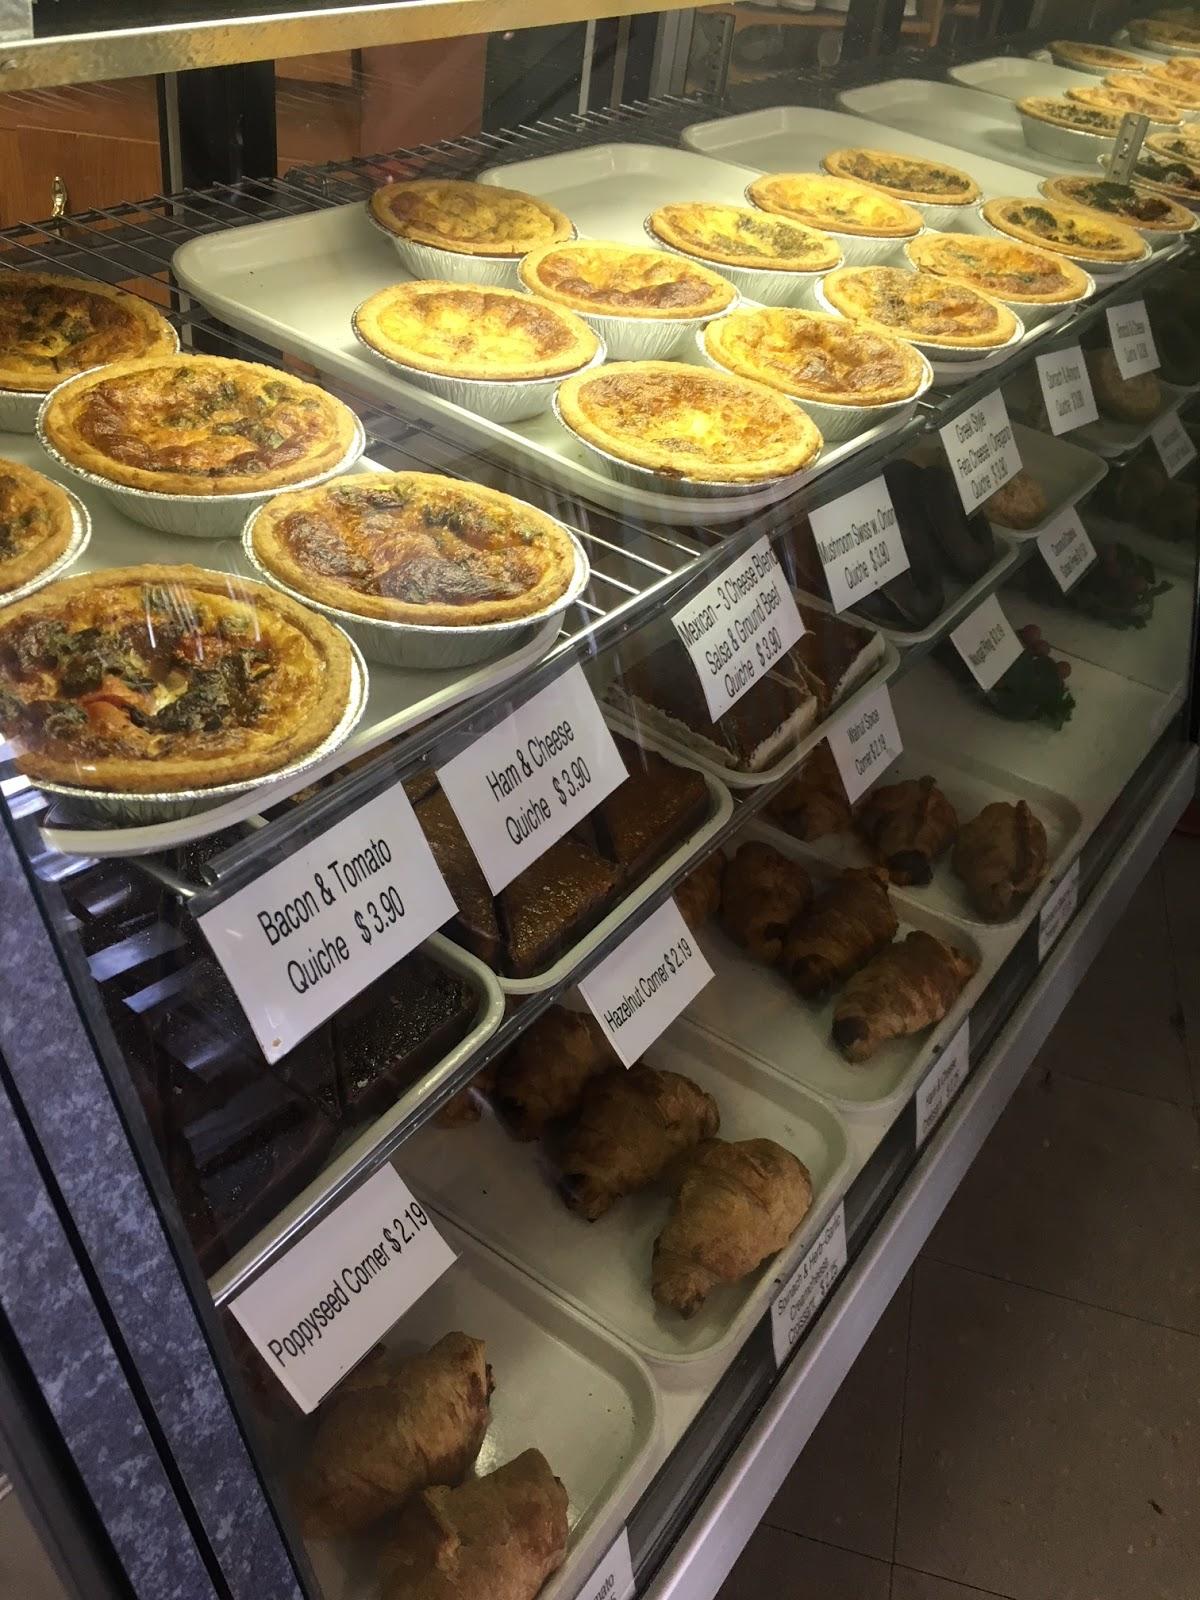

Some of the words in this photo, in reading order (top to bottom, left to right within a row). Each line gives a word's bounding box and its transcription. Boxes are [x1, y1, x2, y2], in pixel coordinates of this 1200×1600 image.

[678, 607, 718, 648] Mexican
[717, 587, 731, 611] 3
[724, 566, 758, 604] Cheese
[705, 641, 733, 675] Salsa
[727, 628, 740, 652] &
[734, 599, 766, 643] Ground
[759, 581, 781, 615] Beef
[724, 660, 755, 698] Quiche
[485, 764, 522, 802] Ham
[516, 749, 534, 778] &
[527, 720, 574, 768] Cheese
[505, 798, 551, 845] Quiche
[257, 891, 320, 946] Bacon
[314, 873, 336, 906] &
[327, 839, 392, 893] Tomato
[287, 936, 350, 994] Quiche
[603, 986, 646, 1033] Hazelnut
[639, 963, 669, 998] Corner
[267, 1280, 350, 1367] Poppyseed
[341, 1242, 391, 1294] Corner
